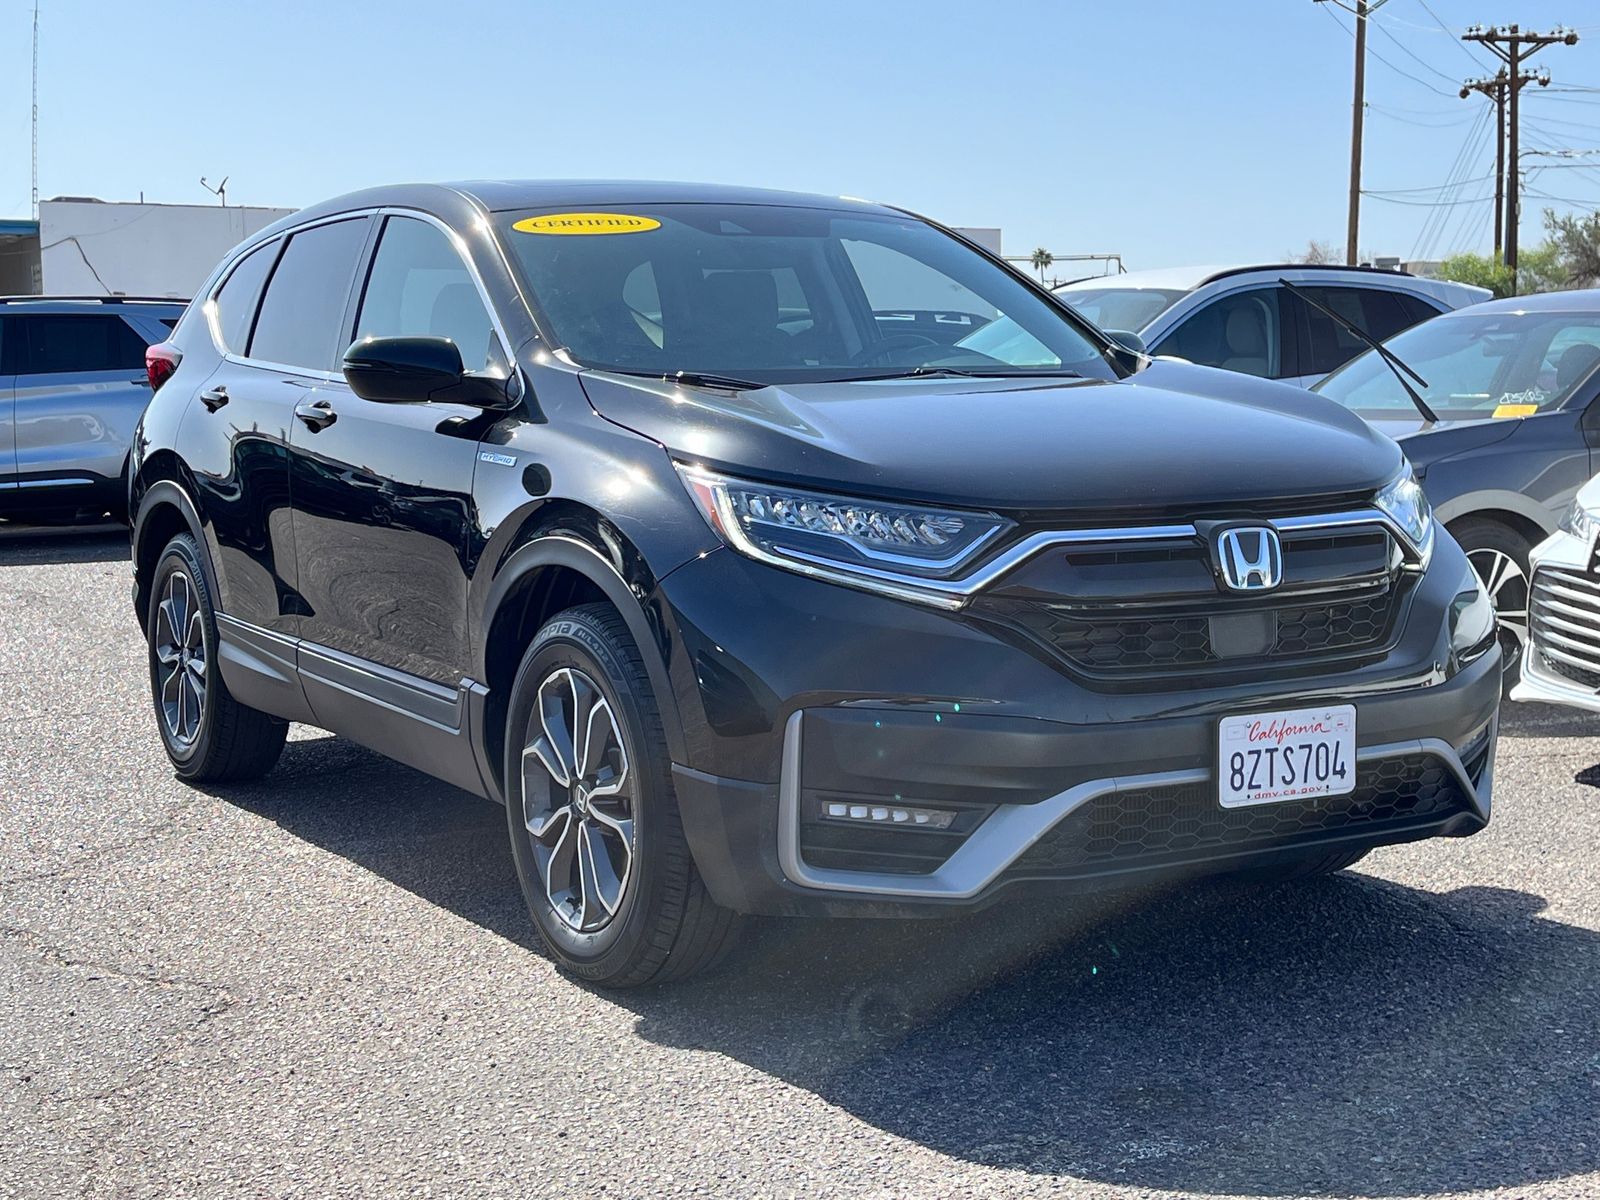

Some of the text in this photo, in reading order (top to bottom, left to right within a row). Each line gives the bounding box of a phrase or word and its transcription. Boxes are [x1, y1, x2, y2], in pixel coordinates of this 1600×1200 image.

[532, 219, 642, 229] CERTIFIED
[482, 453, 513, 464] HYBRID
[1249, 718, 1330, 745] California
[1230, 740, 1347, 792] 8ZTS704
[1254, 785, 1323, 800] dmv.ca.gov
